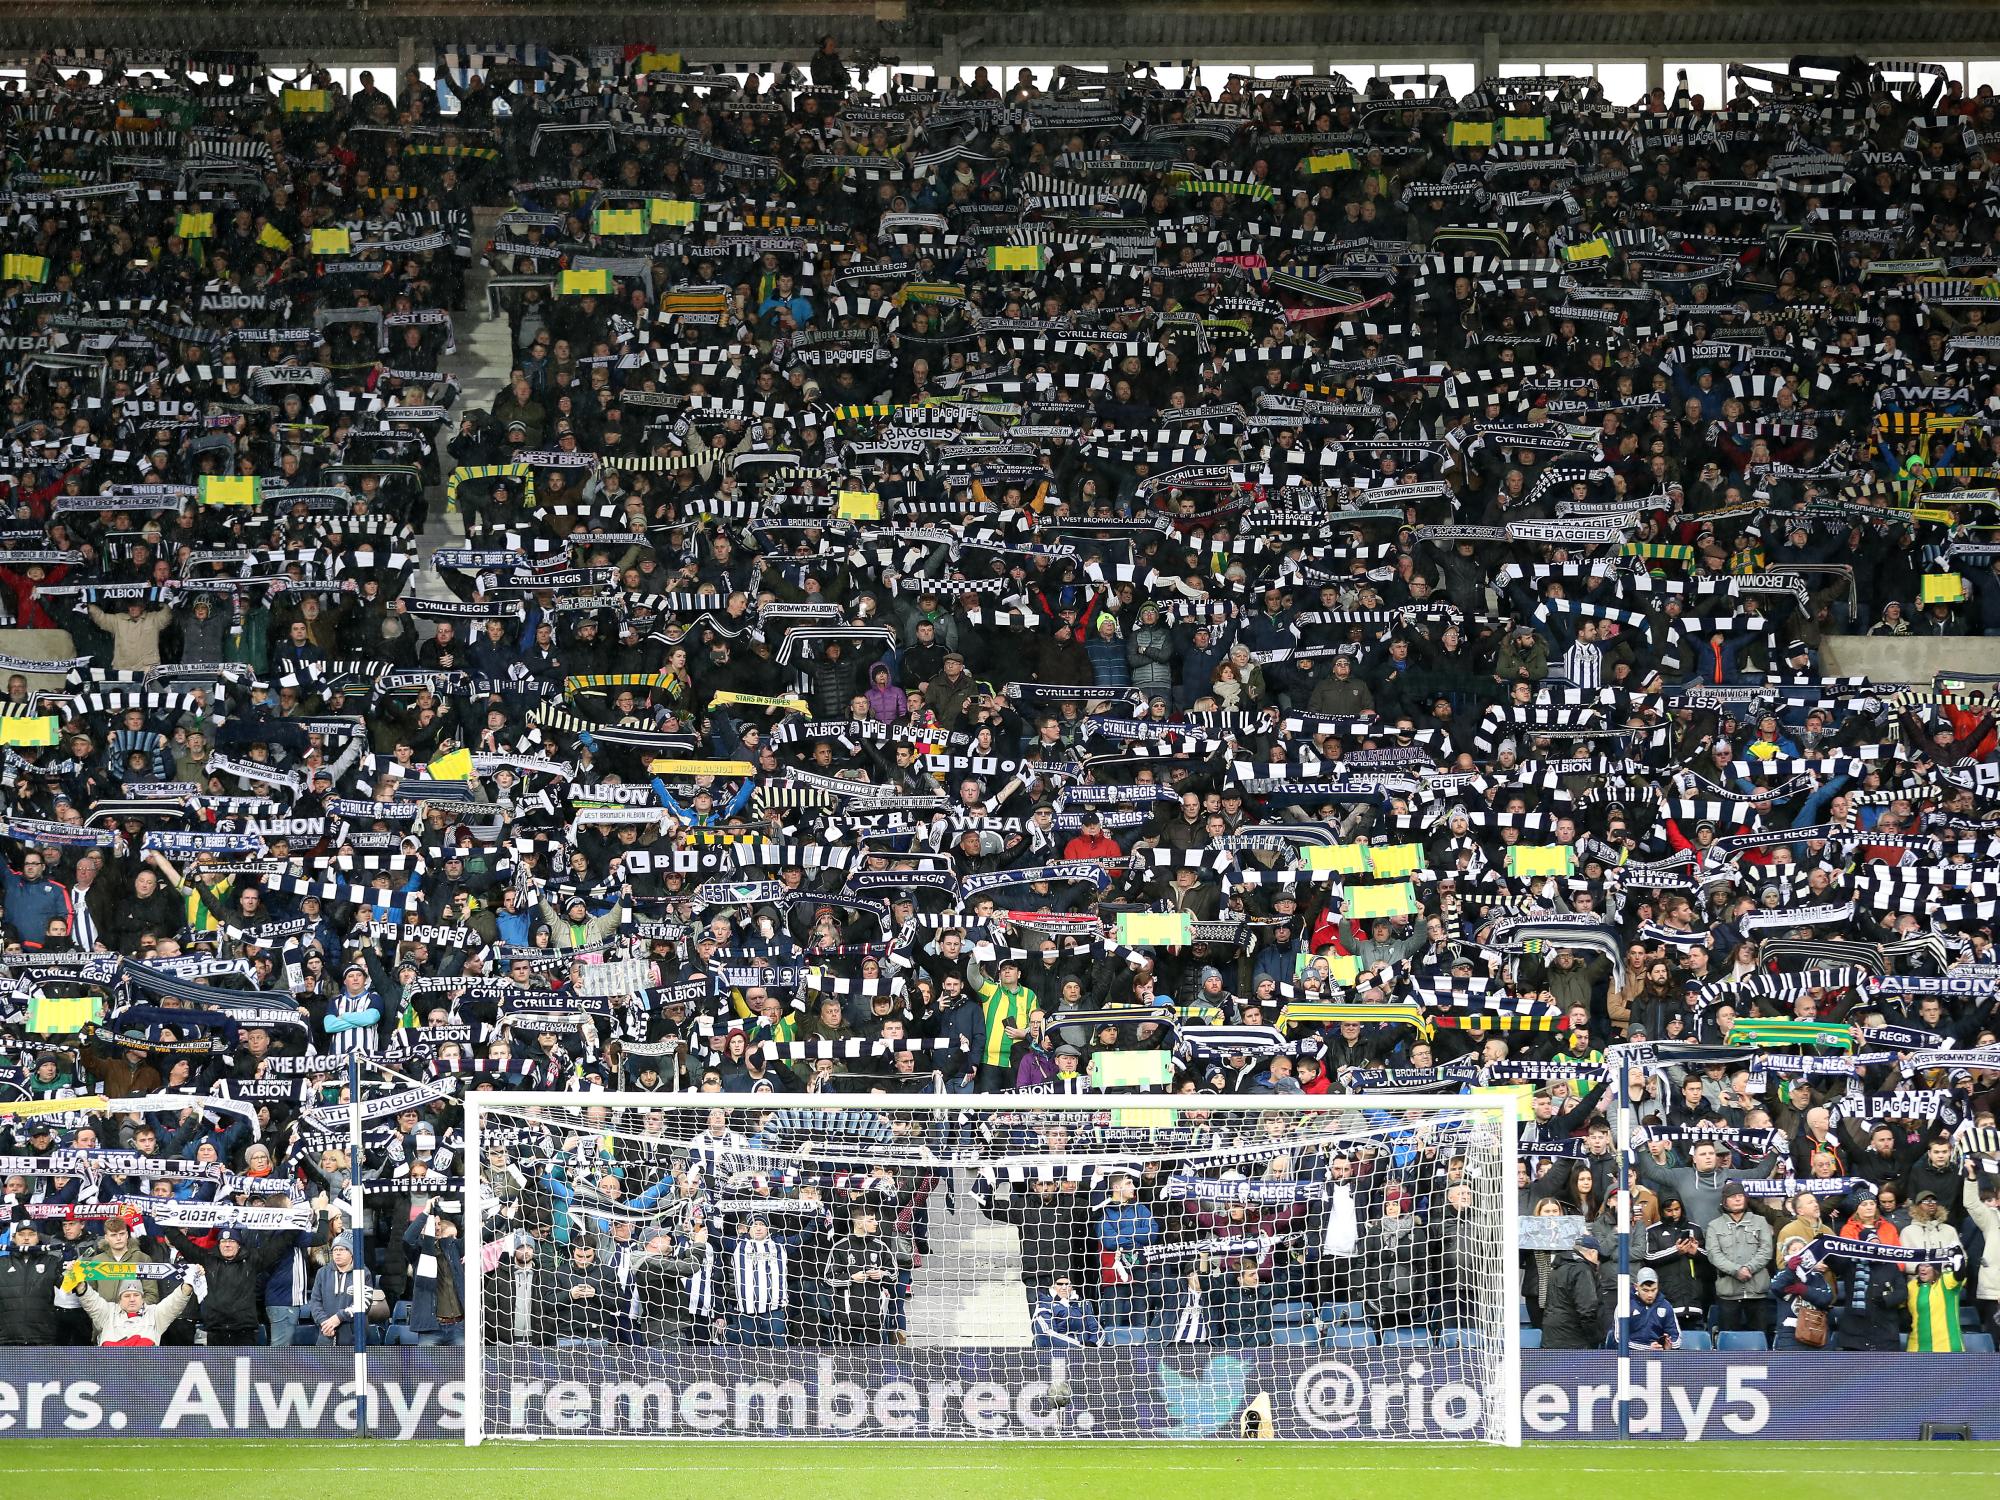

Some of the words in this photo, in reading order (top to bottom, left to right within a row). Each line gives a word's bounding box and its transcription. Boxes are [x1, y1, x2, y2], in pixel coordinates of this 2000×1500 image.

[564, 97, 598, 109] ALBION
[635, 125, 689, 135] ALBION
[1662, 134, 1683, 146] THE
[1864, 152, 1905, 163] WBA
[691, 246, 729, 257] ALBION
[844, 265, 882, 274] CYRILLE
[884, 262, 907, 271] REGIS
[200, 295, 265, 311] ALBION
[1058, 331, 1096, 339] CYRILLE
[799, 350, 821, 361] THE
[826, 350, 873, 362] BAGGIES
[1692, 346, 1731, 357] ALBION
[270, 370, 313, 379] WBA
[1899, 387, 1968, 400] WBA
[1548, 400, 1586, 410] WBA
[1622, 393, 1661, 405] WBA
[906, 408, 925, 418] THE
[932, 408, 978, 419] BAGGIES
[886, 429, 953, 440] BAGGIES
[1495, 436, 1536, 445] CYRILLE
[1539, 440, 1570, 448] REGIS
[1165, 468, 1203, 481] CYRILLE
[1207, 466, 1234, 475] REGIS
[1368, 490, 1384, 500] WEST
[1385, 487, 1416, 498] BROMWICH
[1516, 528, 1541, 537] THE
[1546, 529, 1606, 540] BAGGIES
[509, 576, 549, 584] CYRILLE
[552, 574, 580, 583] REGIS
[104, 588, 143, 598] ALBION
[416, 602, 458, 611] CYRILLE
[462, 603, 489, 612] REGIS
[1035, 688, 1077, 696] CYRILLE
[1081, 689, 1115, 697] REGIS
[862, 722, 886, 736] THE
[894, 725, 947, 744] BAGGIES
[1103, 722, 1136, 734] CYRILLE
[478, 752, 498, 762] THE
[502, 753, 549, 767] BAGGIES
[1353, 774, 1402, 784] BAGGIES
[568, 785, 648, 803] ALBION
[1072, 788, 1106, 799] CYRILLE
[1126, 787, 1156, 798] REGIS
[341, 803, 374, 814] CYRILLE
[1112, 813, 1142, 824] REGIS
[245, 817, 325, 834] ALBION
[954, 817, 1022, 833] WBA
[176, 834, 191, 846] THREE
[205, 835, 226, 846] DEGREES
[1733, 833, 1781, 845] CYRILLE
[1784, 828, 1819, 839] REGIS
[964, 873, 1012, 891] WBA
[1054, 866, 1101, 878] WBA
[1762, 909, 1785, 923] THE
[1788, 904, 1834, 921] BAGGIES
[262, 918, 306, 932] Brom
[371, 923, 397, 939] THE
[404, 924, 465, 947] BAGGIES
[80, 971, 110, 983] REGIS
[1879, 978, 1994, 991] ALBION
[660, 986, 706, 1003] ALBION
[513, 999, 563, 1008] CYRILLE
[262, 1012, 298, 1022] BOING
[419, 1030, 470, 1041] ALBION
[1879, 1031, 1911, 1042] REGIS
[269, 1057, 294, 1072] THE
[1362, 1070, 1382, 1080] WEST
[1446, 1069, 1474, 1079] ALBION
[367, 1085, 441, 1113] BAGGIES
[1873, 1099, 1939, 1118] BAGGIES
[1530, 1142, 1563, 1151] REGIS
[100, 1158, 210, 1171] ALBION
[259, 1178, 290, 1191] REGIS
[1743, 1182, 1783, 1192] CYRILLE
[1806, 1180, 1842, 1190] REGIS
[1195, 1186, 1235, 1197] CYRILLE
[1260, 1187, 1295, 1198] REGIS
[74, 1204, 118, 1214] UNITED
[1824, 1241, 1873, 1255] CYRILLE
[1878, 1246, 1914, 1258] REGIS
[161, 1357, 464, 1441] Always
[510, 1356, 1094, 1430] remembered.
[1294, 1360, 1770, 1442] @rioerdy5
